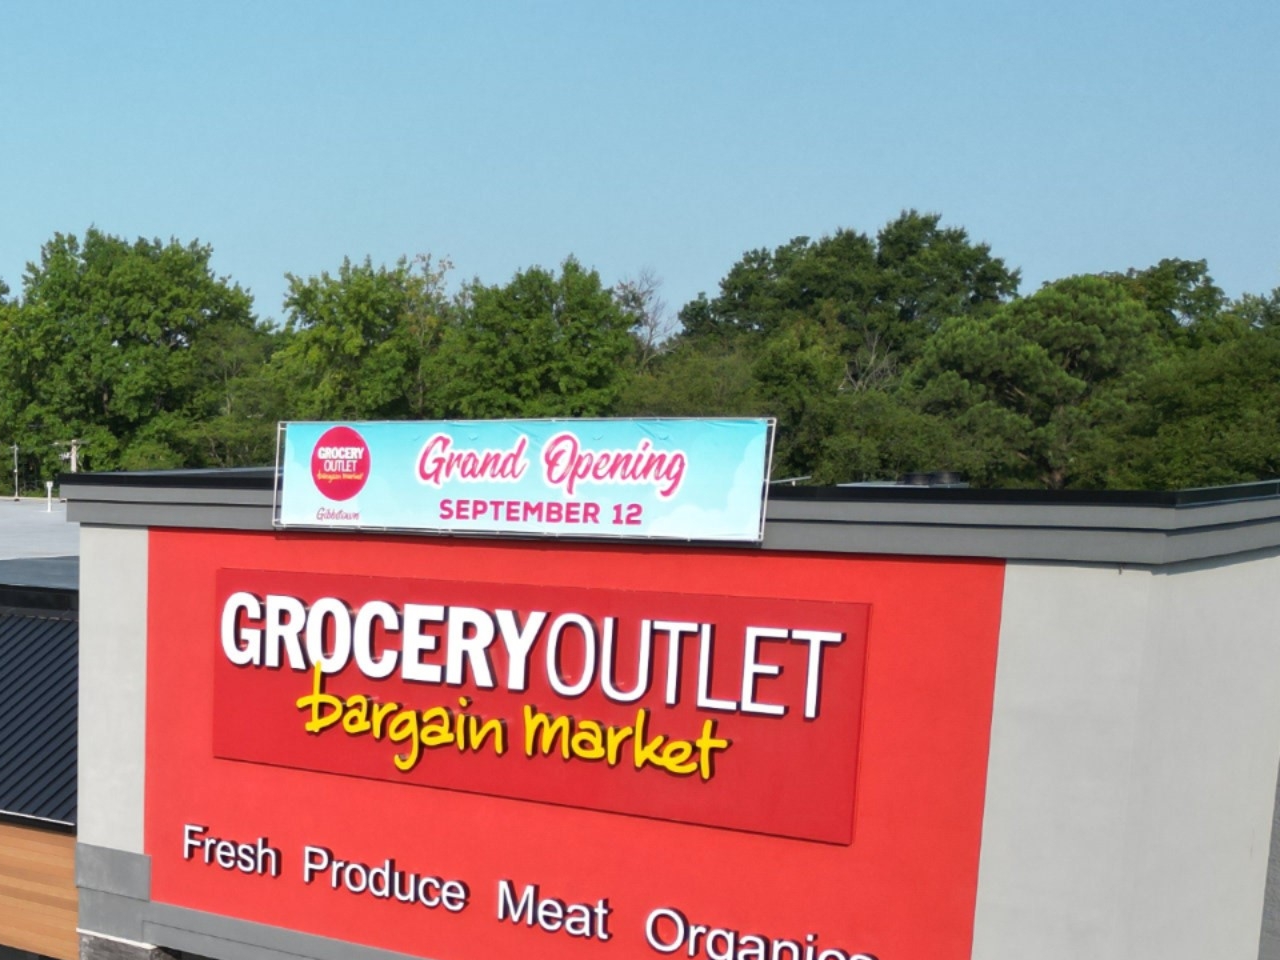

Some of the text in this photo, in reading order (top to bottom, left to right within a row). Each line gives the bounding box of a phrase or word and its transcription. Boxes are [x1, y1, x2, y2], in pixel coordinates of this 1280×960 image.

[317, 446, 365, 460] GROCERY
[323, 459, 358, 473] OUTLET
[418, 434, 686, 497] Grand Opening
[439, 498, 643, 525] SEPTEMBER 12
[296, 661, 729, 780] bargain market
[183, 824, 280, 877] Fresh
[302, 846, 467, 912] Produce
[497, 880, 611, 940] Meat
